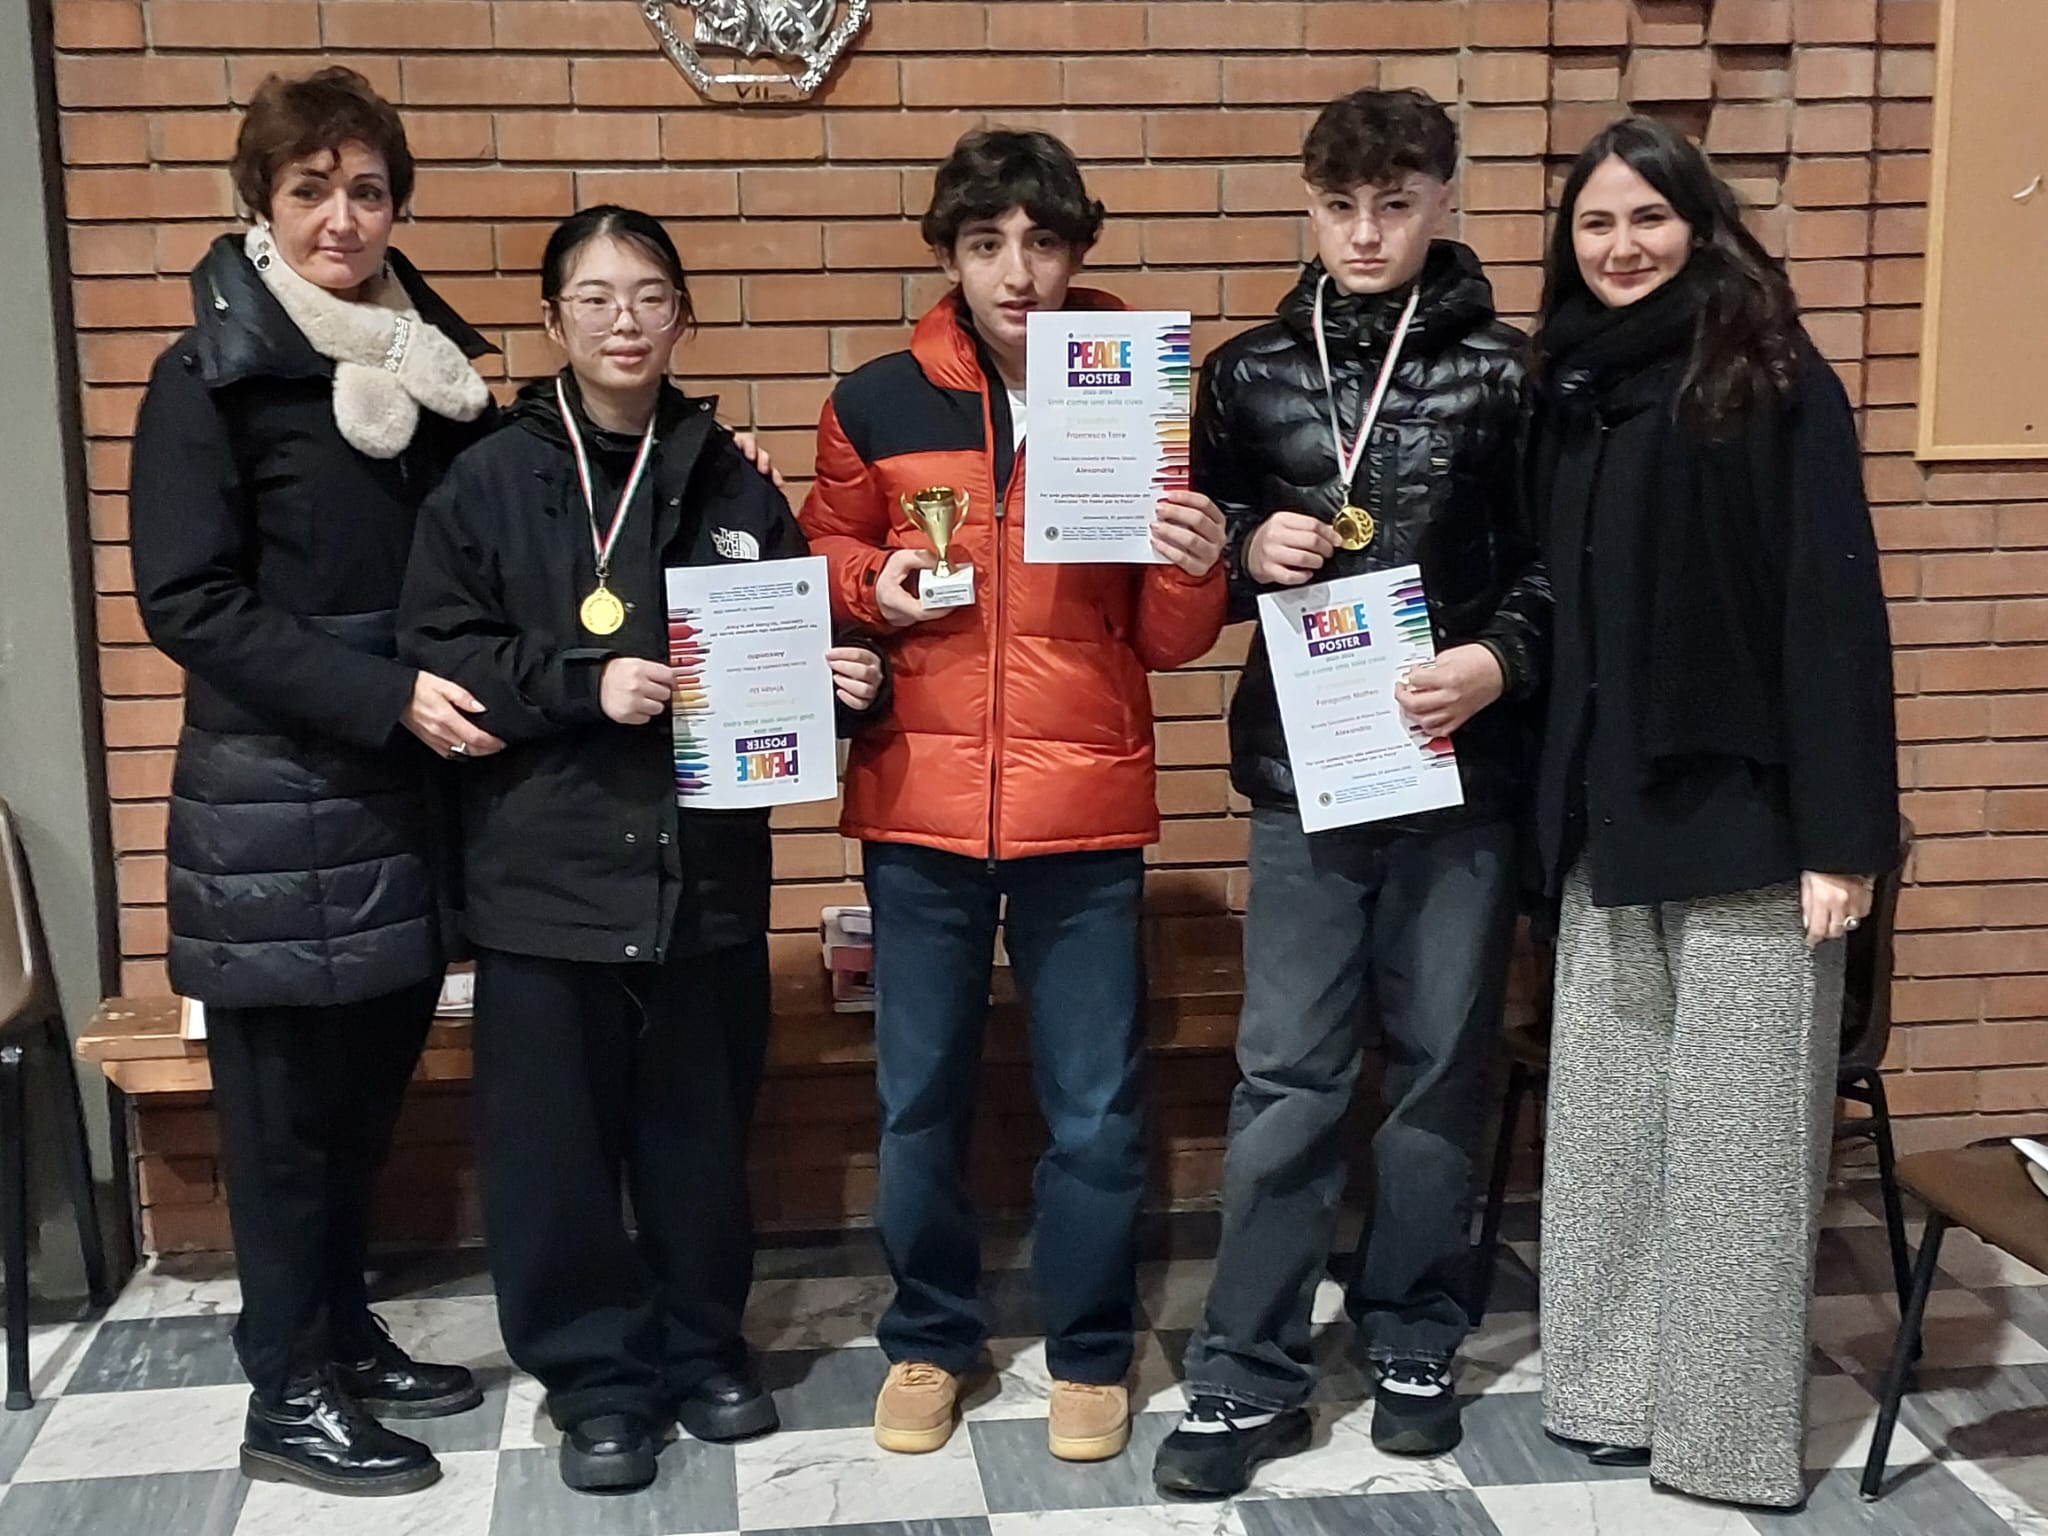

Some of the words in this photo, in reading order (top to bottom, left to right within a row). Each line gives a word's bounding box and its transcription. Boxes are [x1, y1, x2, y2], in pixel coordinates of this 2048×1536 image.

[1068, 341, 1132, 368] PEACE
[1078, 374, 1120, 384] POSTER
[719, 527, 740, 540] THE
[1302, 603, 1368, 640] PEACE
[1318, 636, 1360, 653] POSTER
[746, 736, 788, 750] POSTER
[736, 750, 799, 782] PEACE
